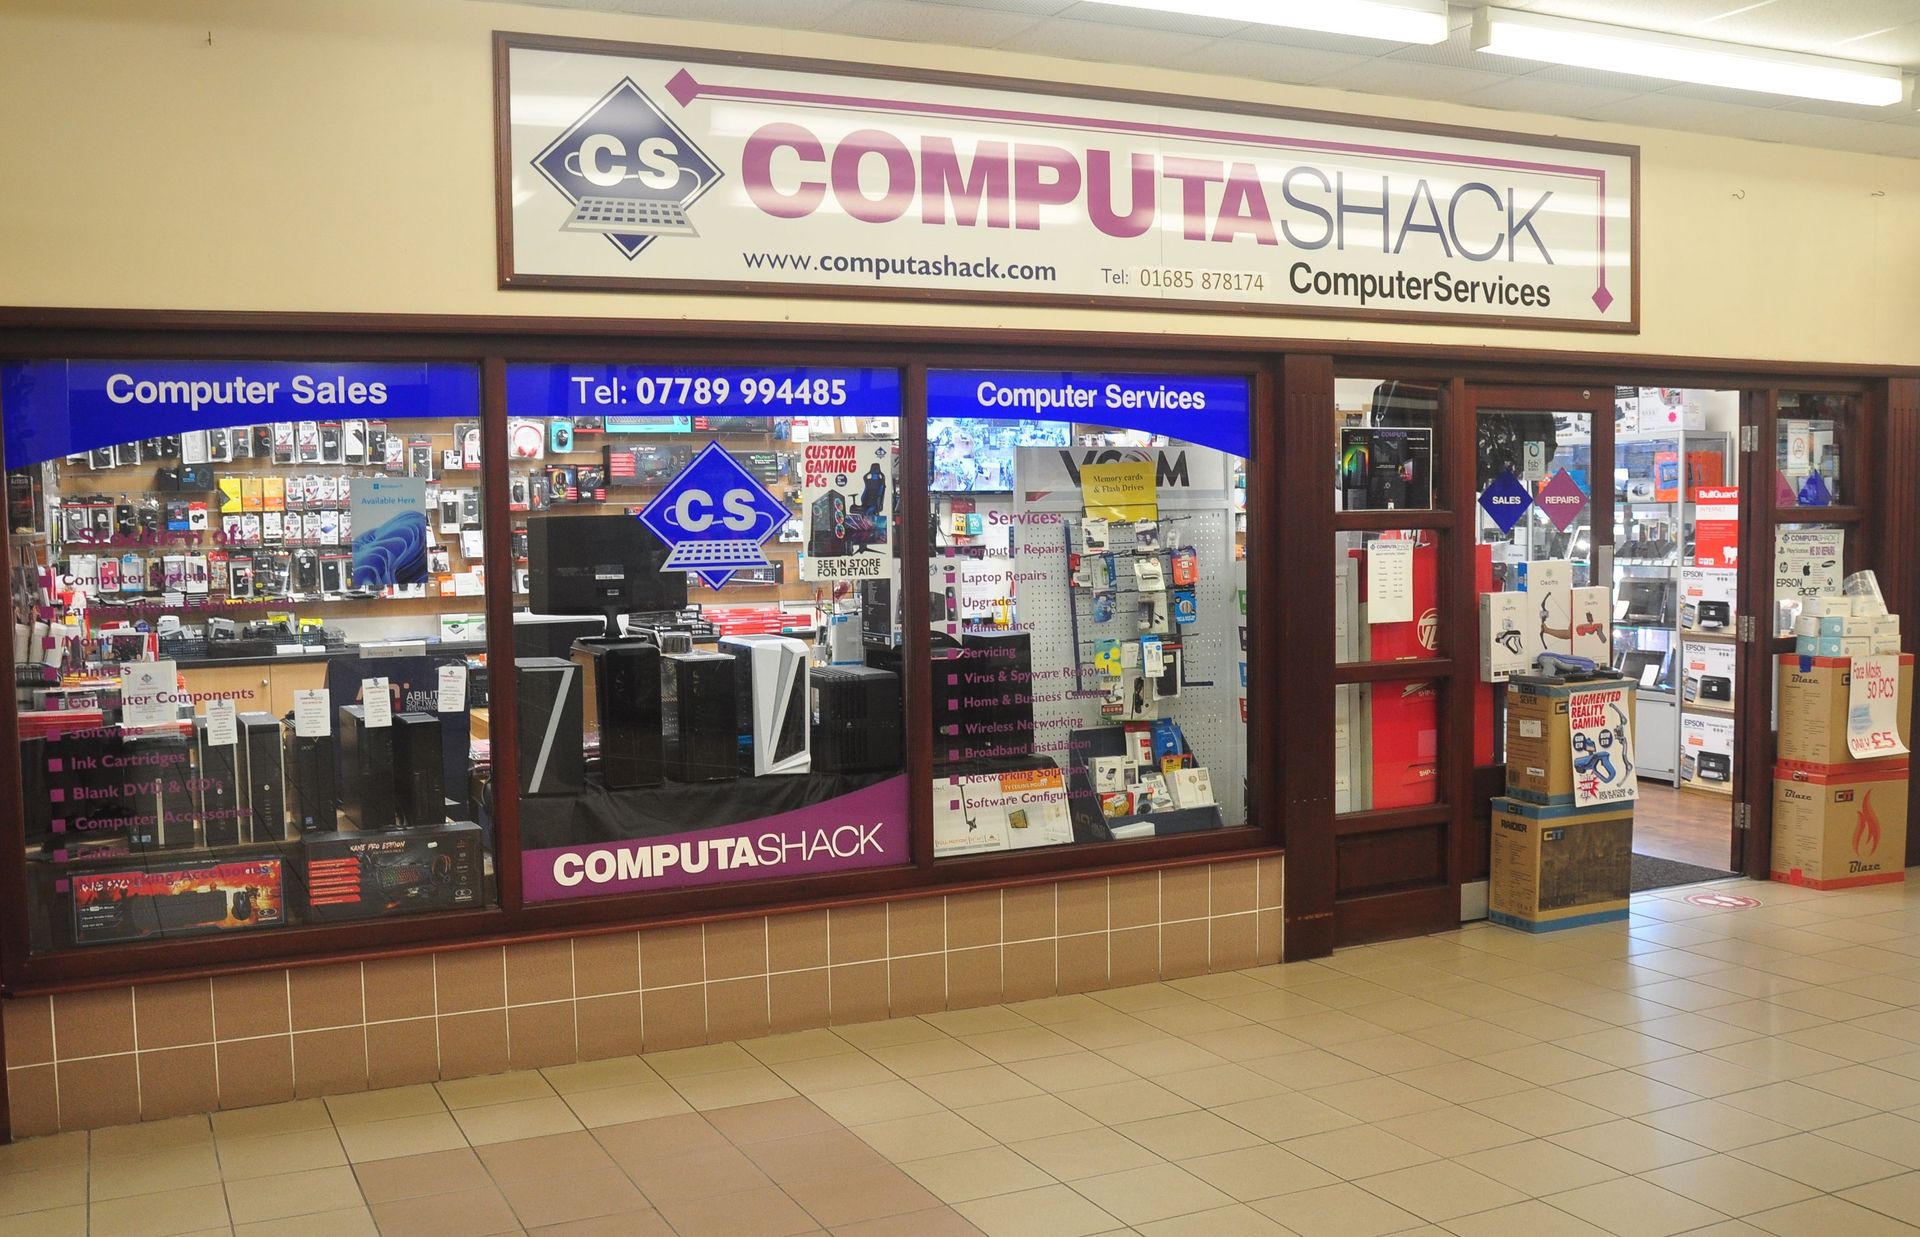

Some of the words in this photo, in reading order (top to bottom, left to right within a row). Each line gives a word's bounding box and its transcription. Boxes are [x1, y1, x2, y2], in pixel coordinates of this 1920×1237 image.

[578, 133, 681, 190] CS
[741, 121, 1555, 265] COMPUTASHACK
[742, 251, 1057, 281] www.computashack.com
[1101, 267, 1129, 286] Tel:
[1140, 268, 1195, 290] 01685
[1201, 271, 1265, 292] 878174
[1289, 261, 1551, 307] ComputerServices
[106, 373, 280, 411] Computer
[291, 374, 388, 405] Sales
[571, 376, 627, 405] Tel:
[636, 377, 730, 405] 07789
[739, 377, 848, 406] 994485
[976, 381, 1098, 413] Computer
[1105, 383, 1206, 410] Services
[805, 445, 856, 460] CUSTOM
[805, 459, 857, 474] GAMING
[805, 474, 828, 488] PCs
[1093, 475, 1121, 485] Memory
[1102, 484, 1120, 493] Flash
[1122, 484, 1145, 492] Drives
[1699, 490, 1738, 499] BullGuard
[361, 496, 396, 505] Available
[398, 496, 416, 504] Here
[1492, 495, 1521, 505] SALES
[1545, 496, 1580, 505] REPAIRS
[675, 488, 757, 533] CS
[988, 510, 1062, 525] Services:
[962, 545, 1020, 557] Computer
[1023, 543, 1065, 557] Repairs
[817, 559, 834, 568] SEE
[836, 559, 846, 568] IN
[849, 558, 881, 568] STORE
[817, 568, 837, 577] FOR
[840, 567, 879, 576] DETAILS
[961, 572, 1001, 585] Laptop
[1005, 570, 1047, 583] Repairs
[1683, 570, 1703, 578] EPSON
[62, 572, 144, 589] Computer
[1776, 578, 1803, 588] EPSON
[1797, 586, 1820, 596] acer
[962, 596, 1017, 610] Upgrades
[963, 620, 1035, 633] Maintenance
[963, 646, 1017, 659] Servicing
[1685, 644, 1706, 652] EPSON
[964, 672, 995, 684] Virus
[997, 671, 1007, 682] &
[1010, 669, 1061, 683] Spyware
[1062, 664, 1109, 678] Removal
[1791, 673, 1820, 686] Blaze
[1867, 681, 1877, 699] 50
[1879, 677, 1895, 699] PCS
[156, 687, 255, 705] Components
[964, 696, 999, 708] Home
[1002, 694, 1012, 706] &
[1014, 692, 1061, 705] Business
[1520, 695, 1538, 705] SEVEN
[1570, 690, 1621, 707] AUGMENTED
[1571, 703, 1605, 719] REALITY
[965, 723, 1014, 735] Wireless
[1017, 717, 1084, 731] Networking
[1572, 715, 1606, 730] GAMING
[1684, 719, 1704, 728] EPSON
[965, 745, 1028, 759] Broadband
[1030, 739, 1092, 753] Installation
[1851, 737, 1870, 752] ONLY
[1871, 731, 1896, 750] £5
[71, 757, 97, 770] Ink
[102, 752, 186, 768] Cartridges
[965, 769, 1034, 784] Networking
[72, 786, 119, 801] Blank
[123, 781, 163, 797] DVD
[168, 780, 181, 794] &
[1784, 788, 1812, 801] Blaze
[966, 796, 1018, 809] Software
[1021, 789, 1097, 803] Configuration
[75, 814, 157, 831] Computer
[163, 806, 253, 823] Accessories
[1501, 819, 1527, 833] RAIDER
[552, 823, 884, 887] COMPUTASHACK
[1849, 860, 1882, 873] Blaze
